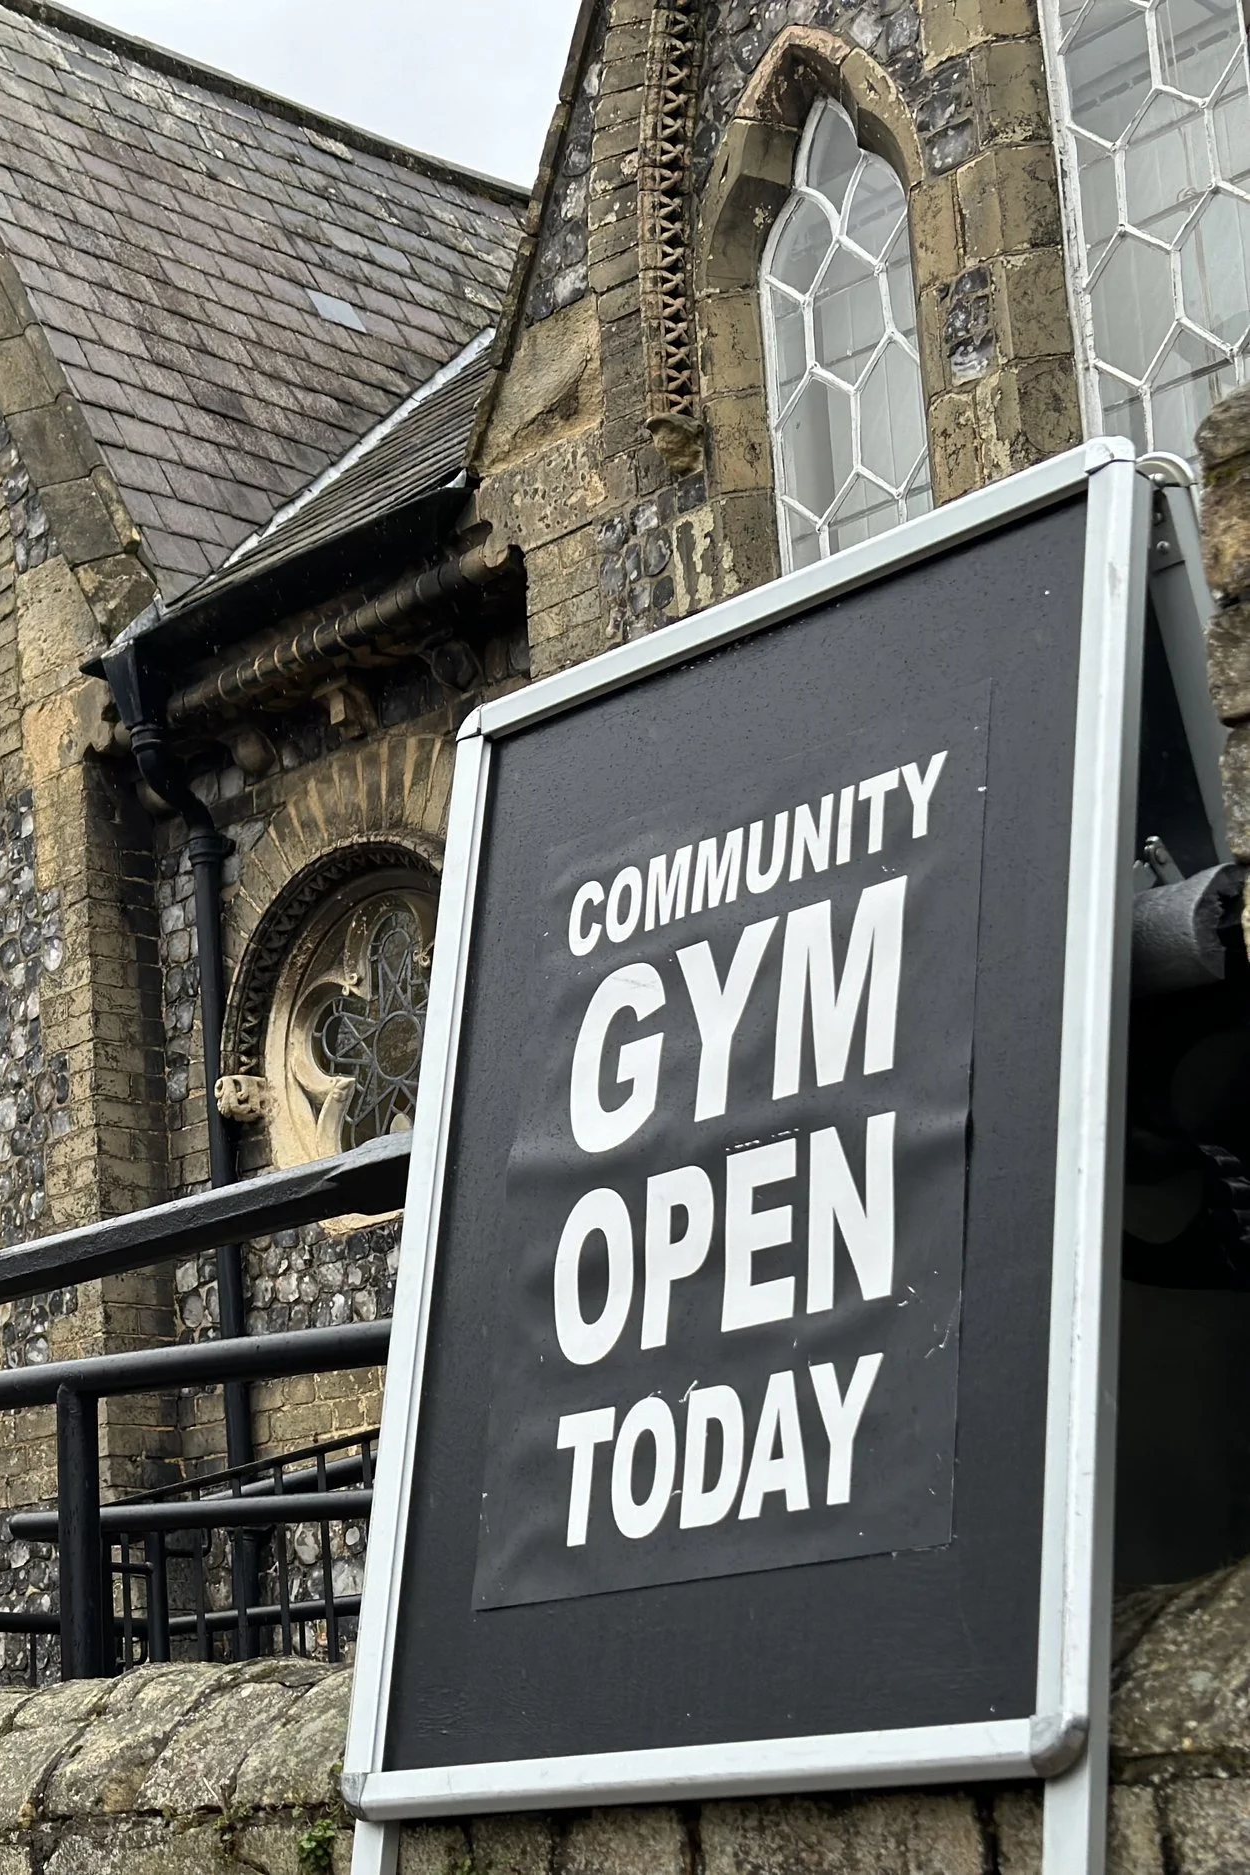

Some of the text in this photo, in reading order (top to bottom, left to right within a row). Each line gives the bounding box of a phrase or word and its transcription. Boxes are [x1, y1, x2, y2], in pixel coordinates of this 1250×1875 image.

[569, 751, 948, 956] COMMUNITY
[570, 875, 908, 1153] GYM
[554, 1111, 896, 1365] OPEN
[557, 1353, 884, 1547] TODAY
